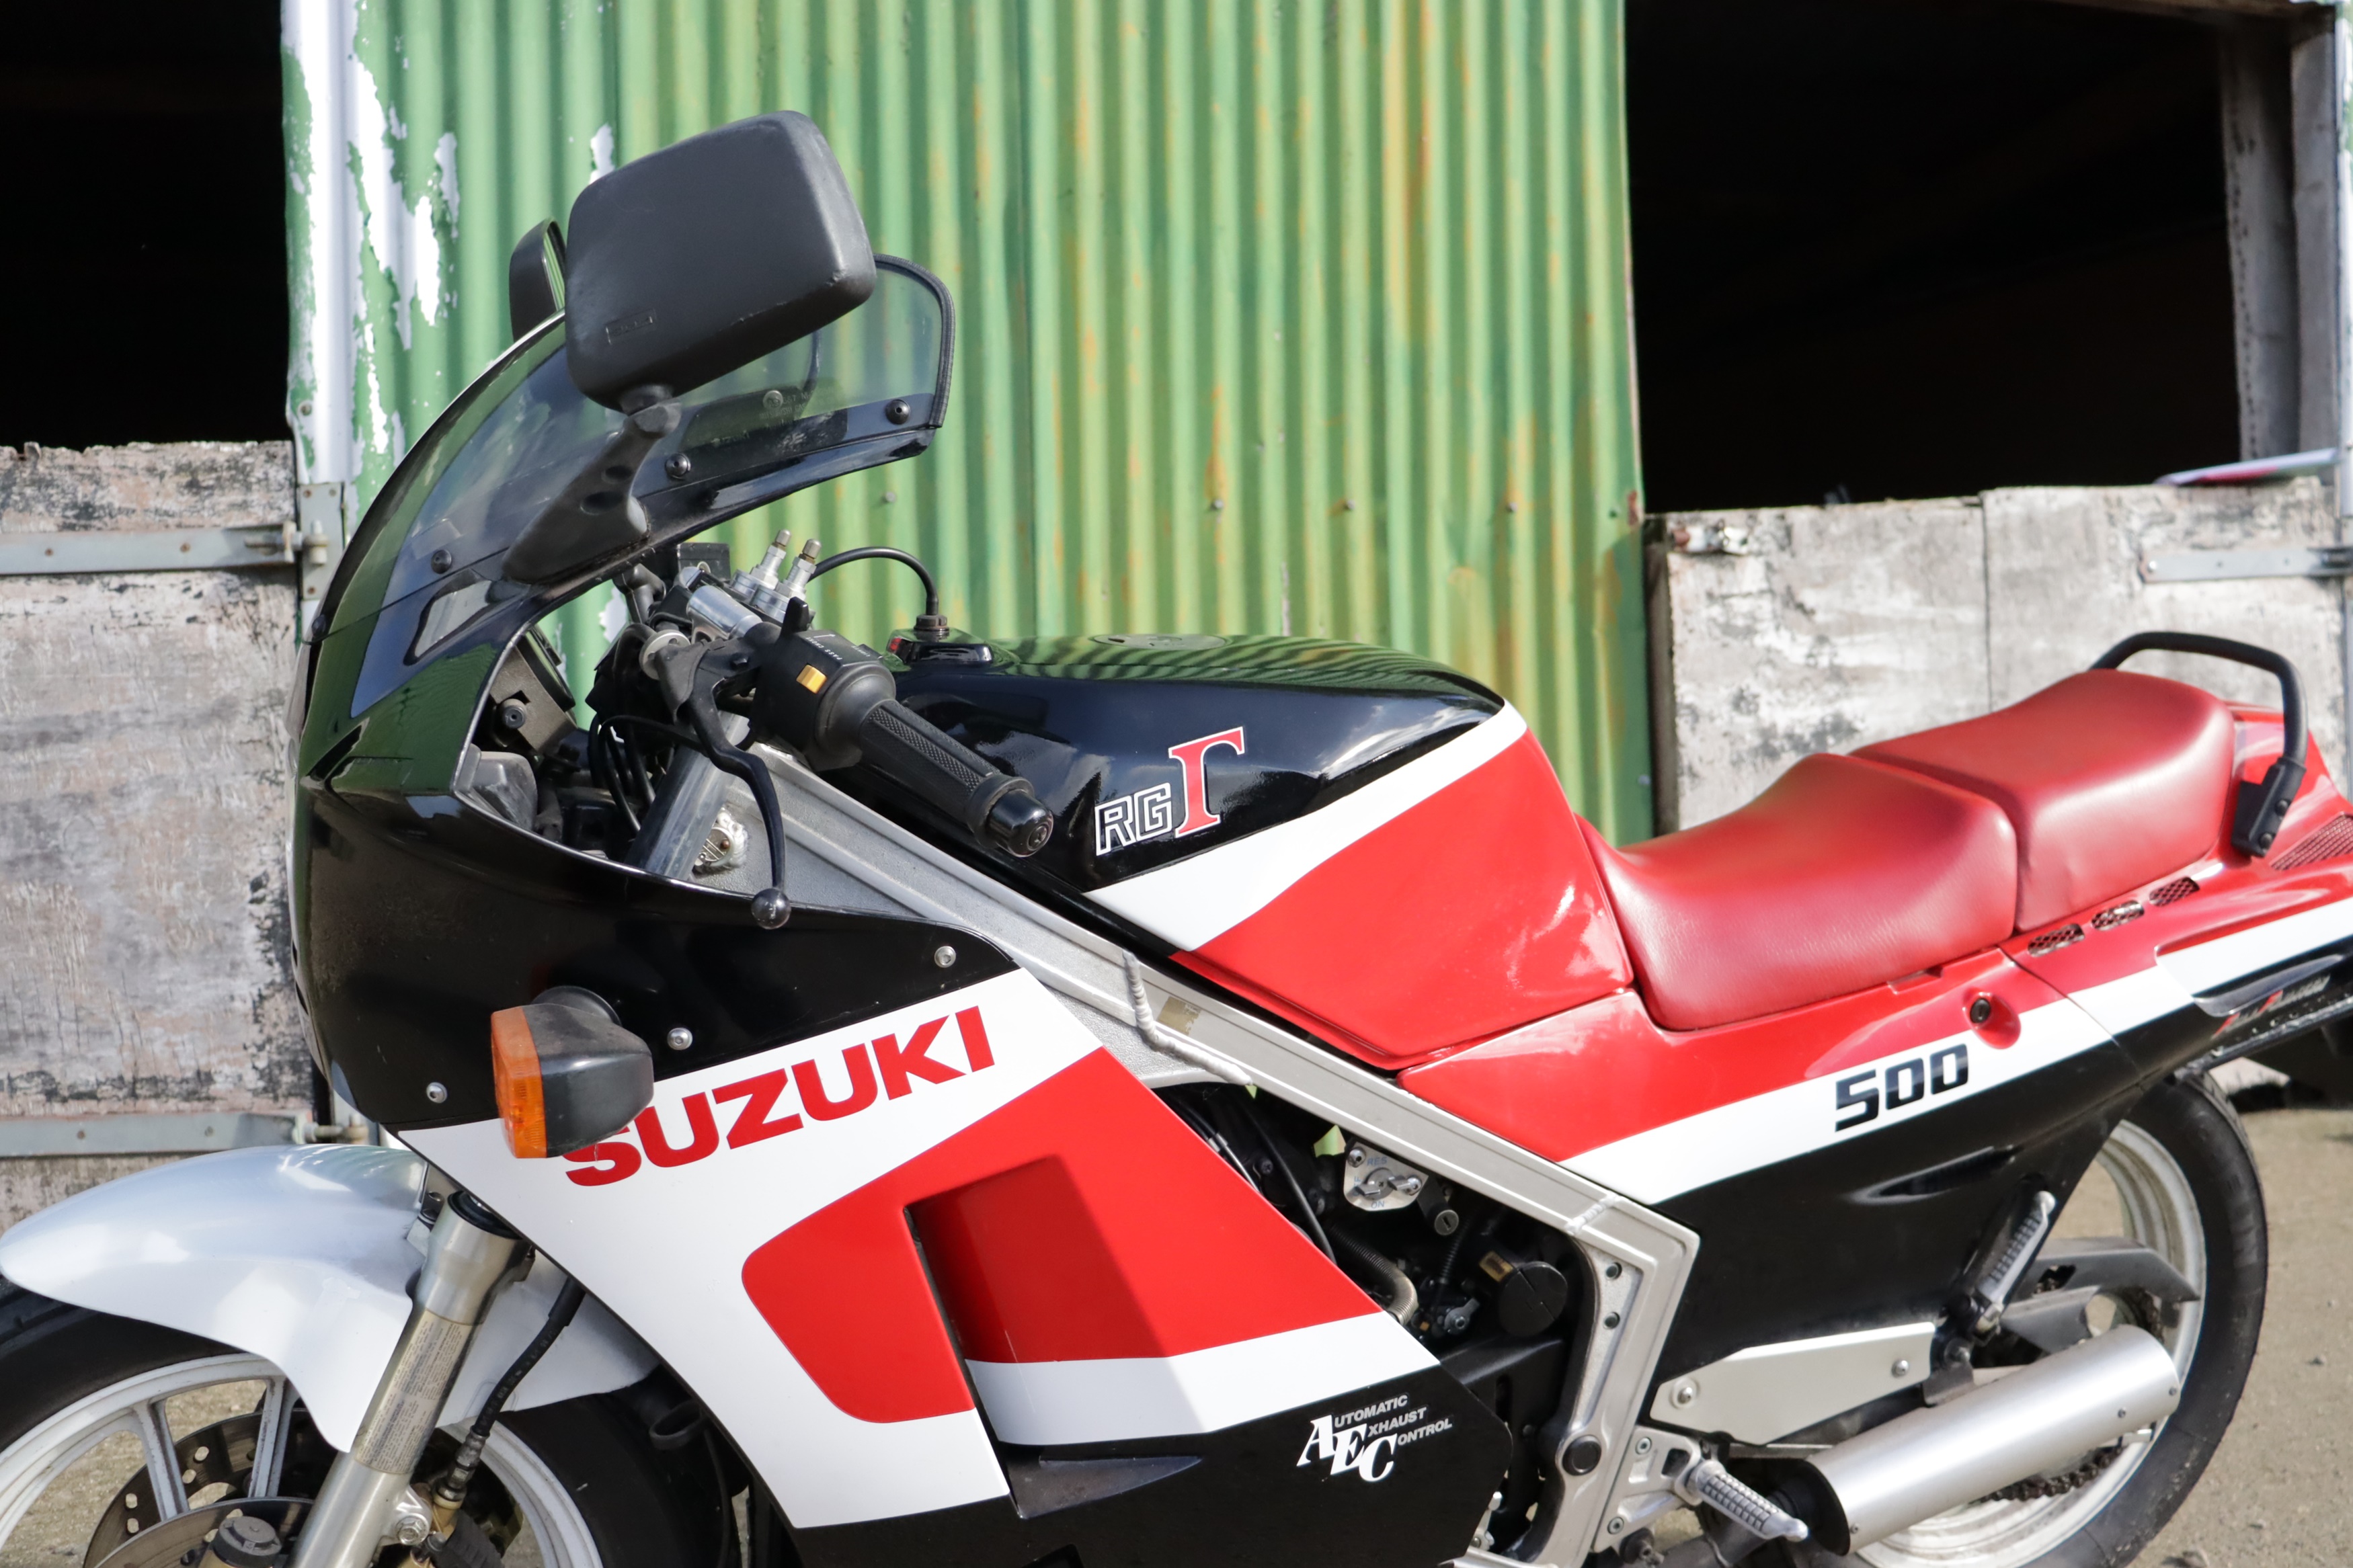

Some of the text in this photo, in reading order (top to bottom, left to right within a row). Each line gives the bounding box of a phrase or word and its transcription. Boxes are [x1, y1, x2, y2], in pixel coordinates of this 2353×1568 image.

[805, 636, 843, 660] PASS CHOKE
[565, 1005, 996, 1187] SUZUKI
[1835, 1043, 1968, 1133] 500
[1367, 1156, 1388, 1166] RES
[1371, 1200, 1385, 1209] ON
